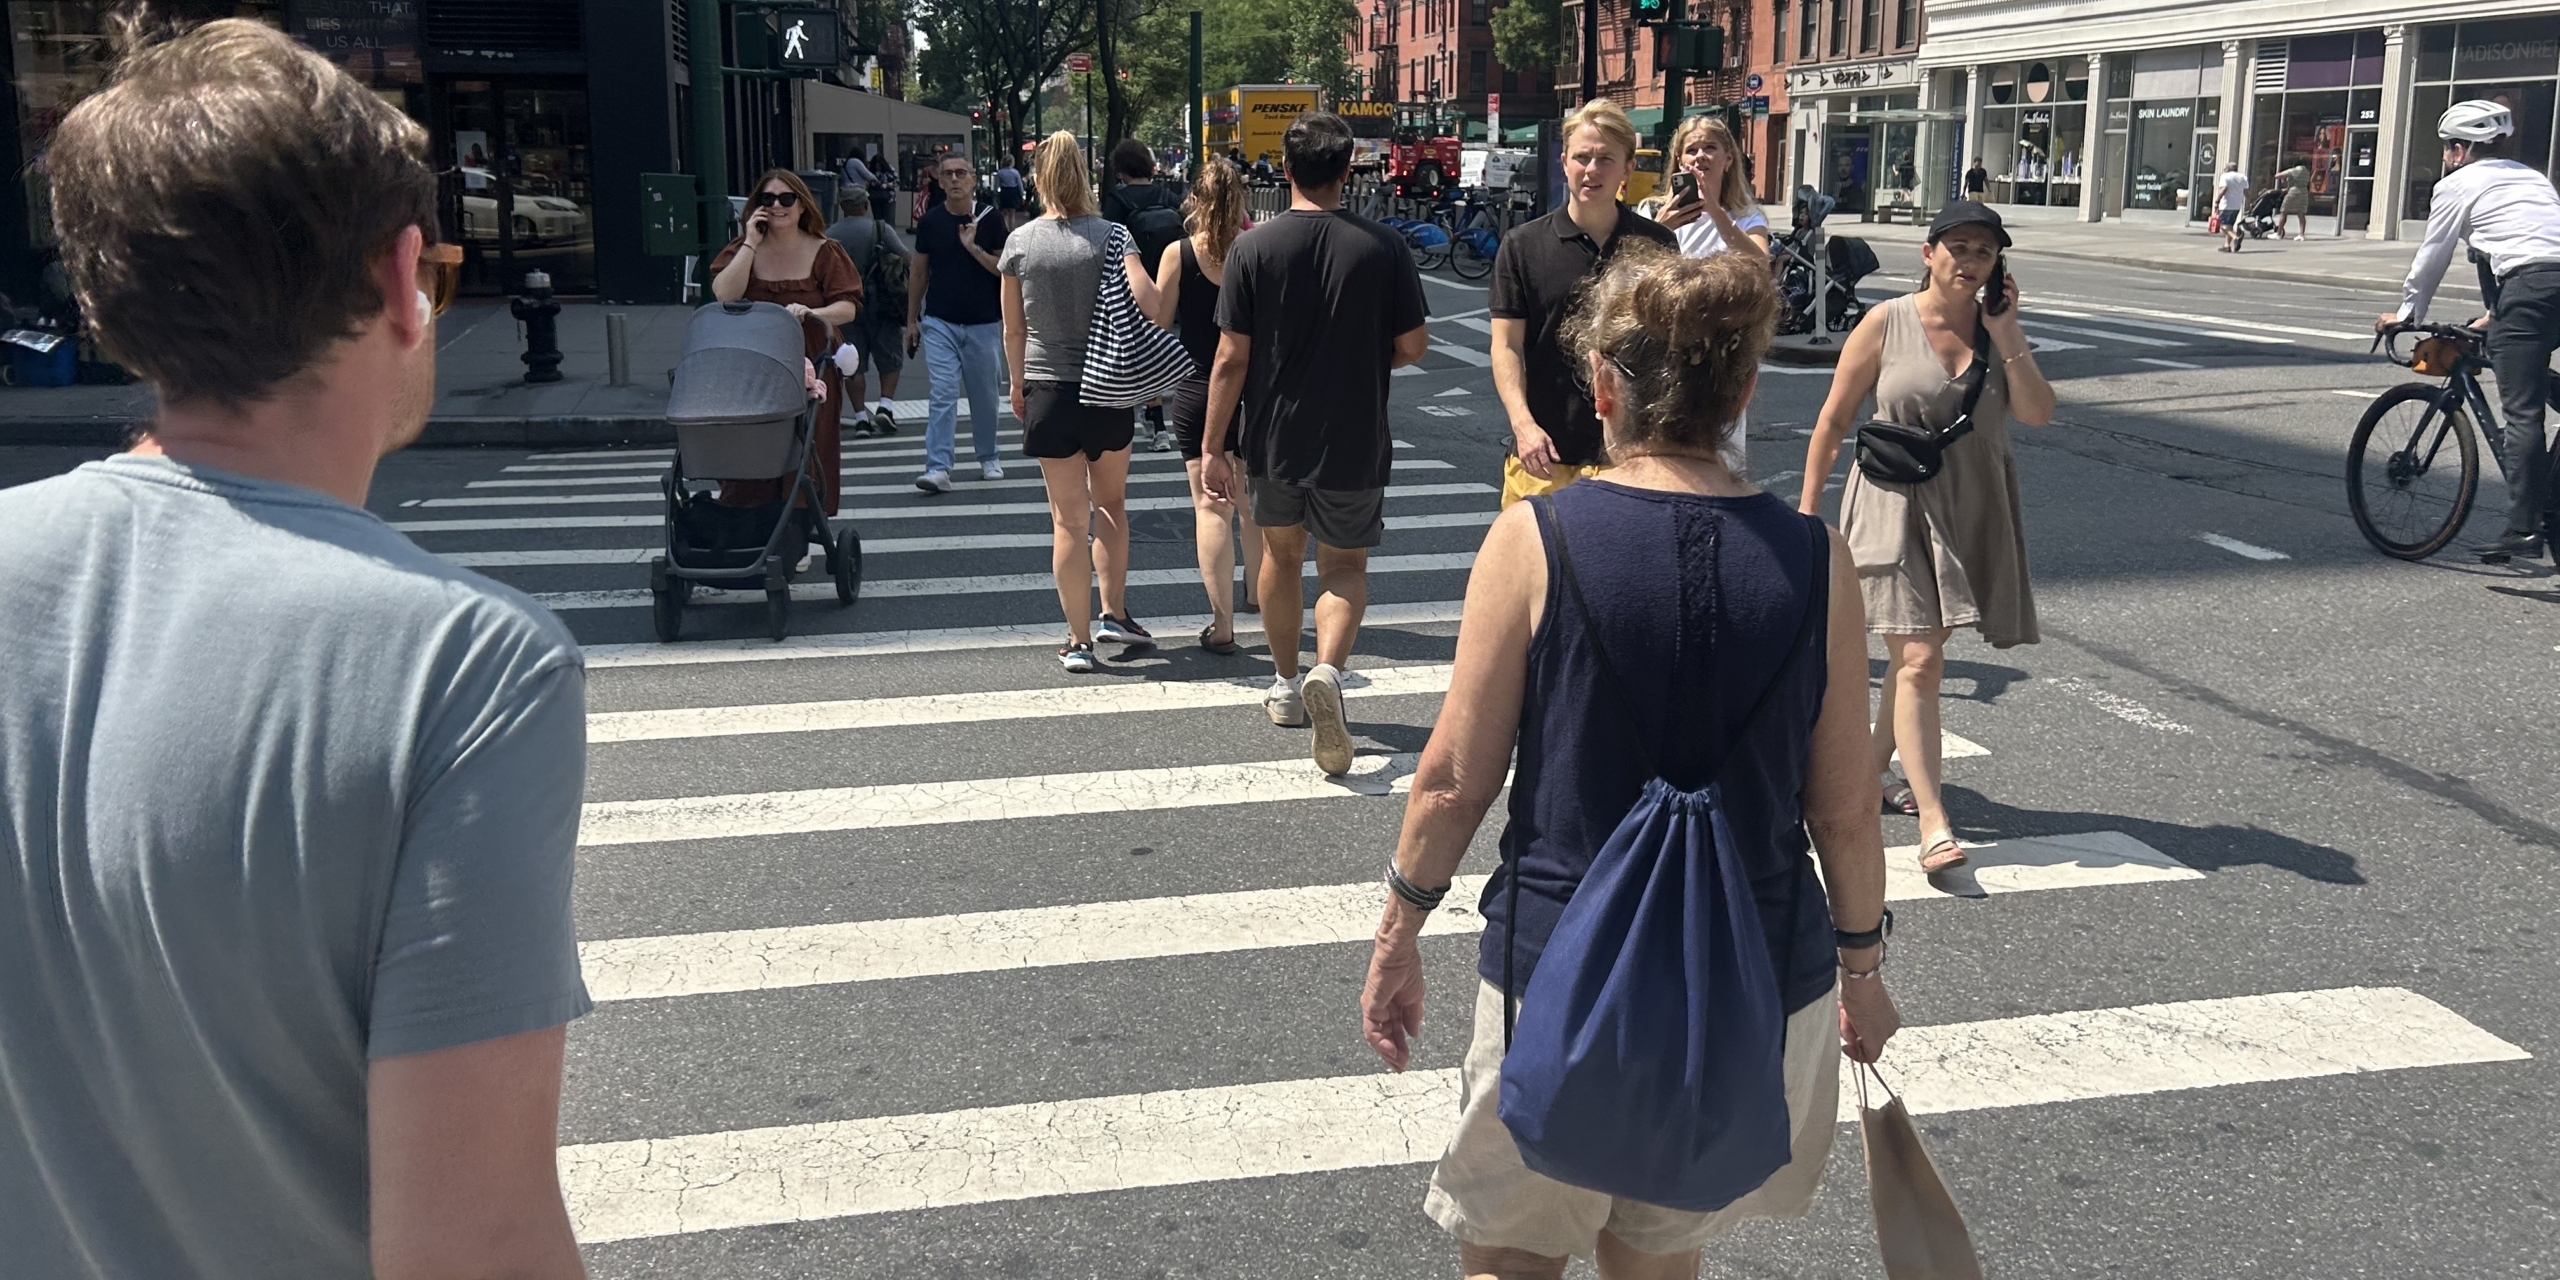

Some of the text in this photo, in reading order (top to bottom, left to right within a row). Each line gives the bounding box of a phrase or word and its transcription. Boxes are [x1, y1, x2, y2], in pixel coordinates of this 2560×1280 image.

[369, 2, 411, 13] THAT
[306, 18, 341, 30] LIES
[326, 36, 348, 48] US
[1251, 103, 1309, 113] PENSKE
[1338, 102, 1394, 116] KAMCO
[2138, 108, 2155, 119] SKIN
[2156, 106, 2190, 118] LAUNDRY
[2360, 110, 2375, 119] 252
[2144, 173, 2157, 181] made
